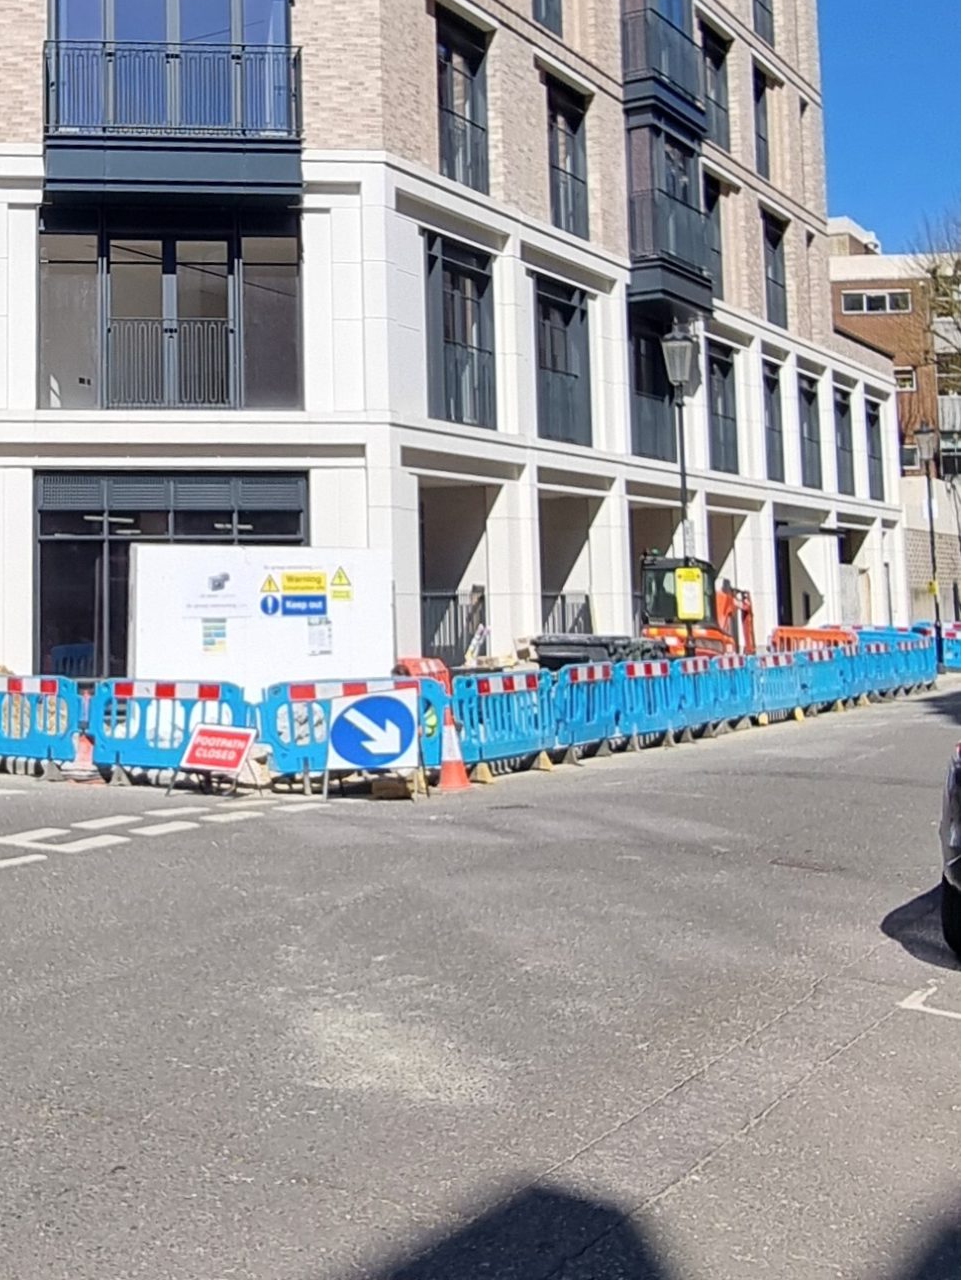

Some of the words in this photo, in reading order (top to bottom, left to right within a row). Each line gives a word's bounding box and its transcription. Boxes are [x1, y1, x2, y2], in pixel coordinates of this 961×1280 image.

[286, 575, 322, 585] Warning
[285, 601, 307, 610] Keep
[309, 601, 323, 609] out
[194, 735, 246, 750] FOOTPATH
[195, 746, 237, 761] CLOSED
